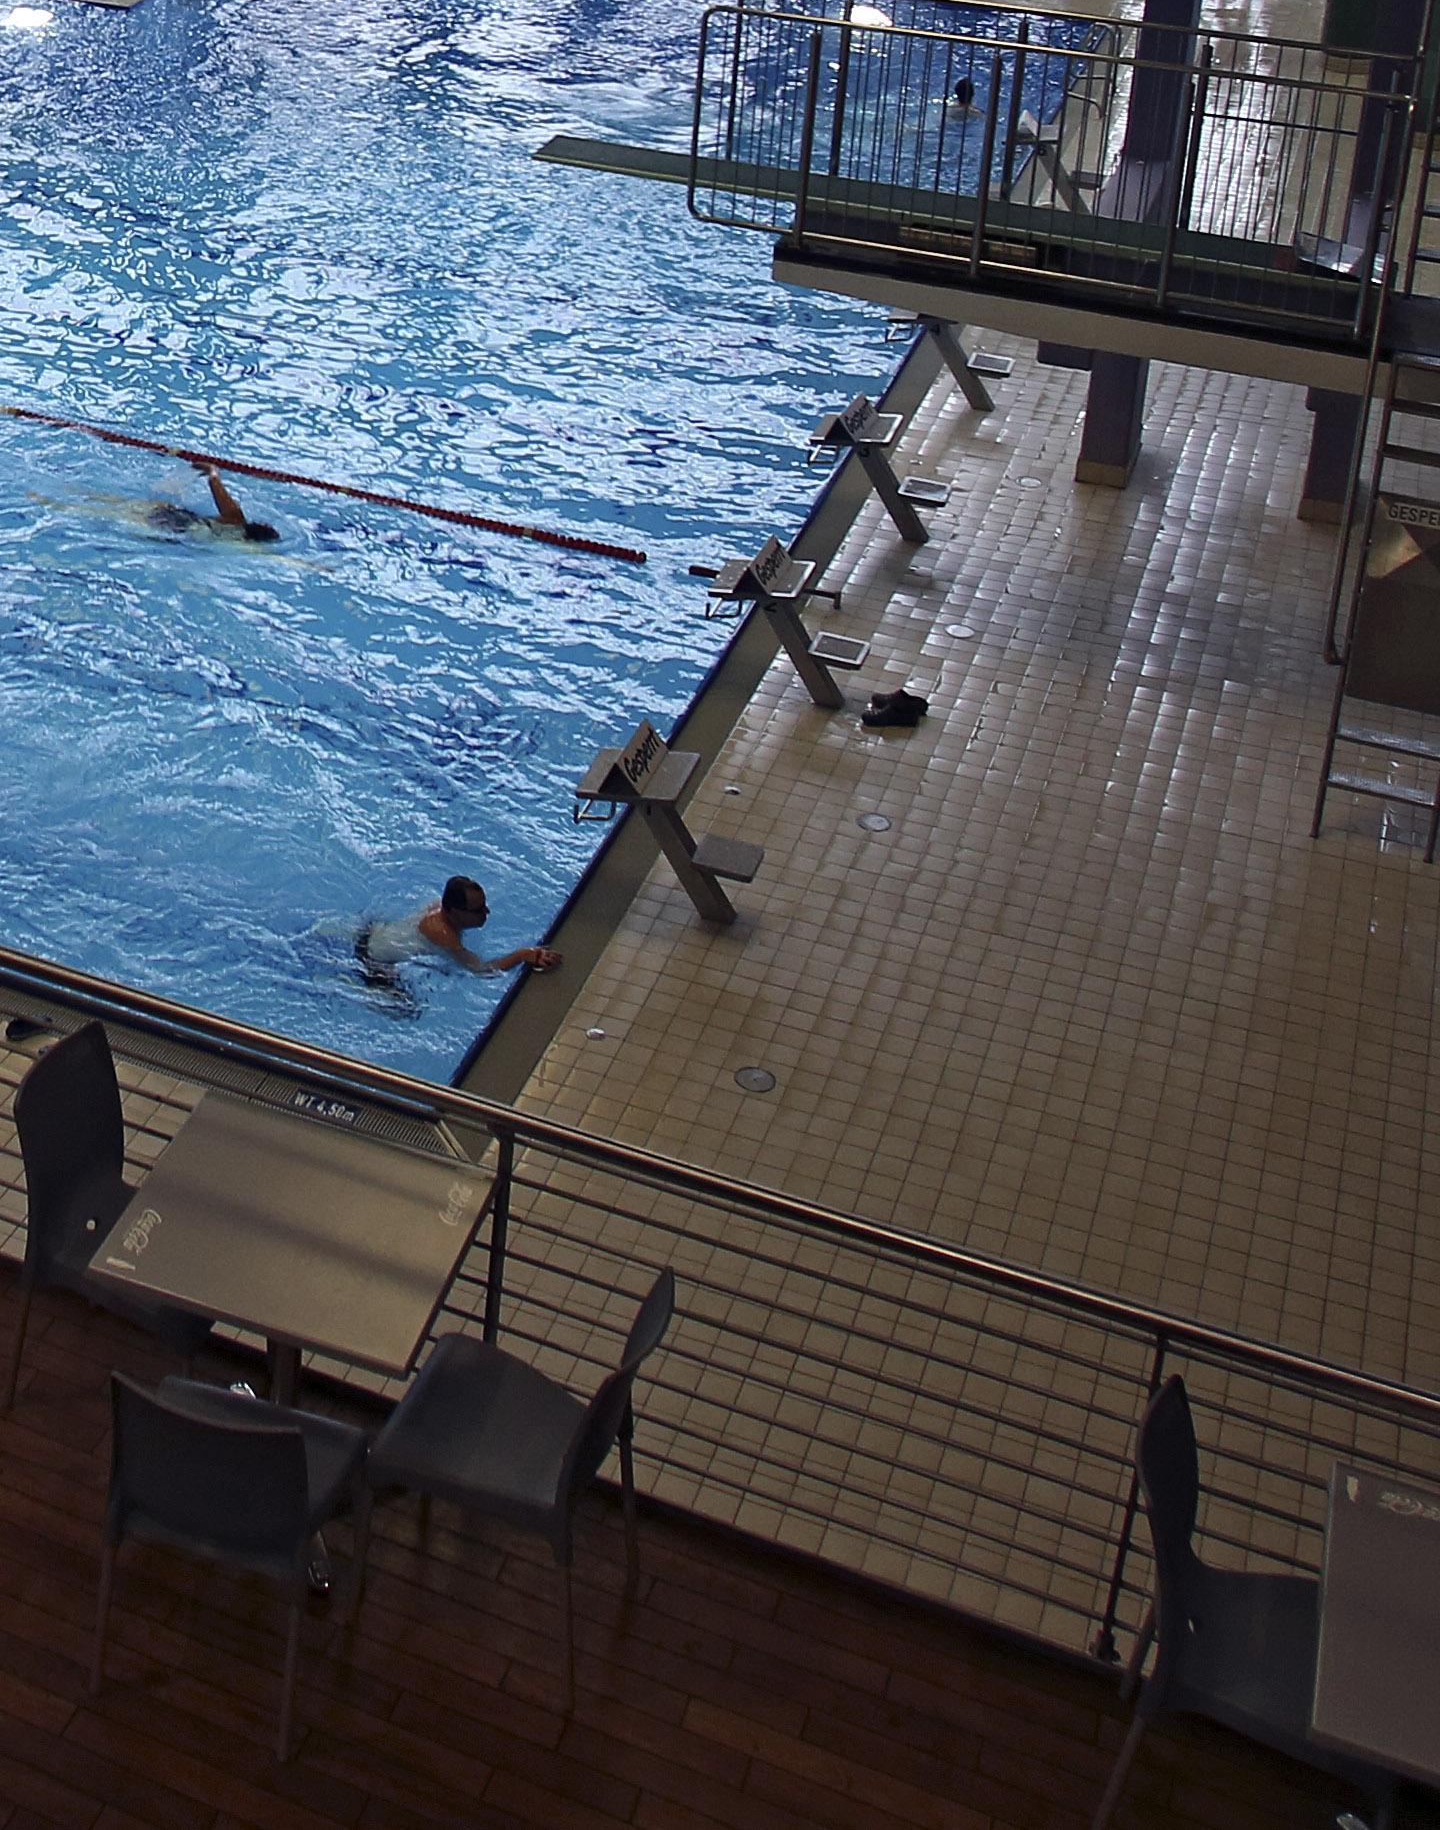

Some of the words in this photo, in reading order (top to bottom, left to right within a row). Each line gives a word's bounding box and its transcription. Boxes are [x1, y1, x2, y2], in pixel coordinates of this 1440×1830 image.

[623, 726, 661, 782] Gesperrt
[294, 1091, 317, 1109] WT
[316, 1099, 355, 1122] 4,50m
